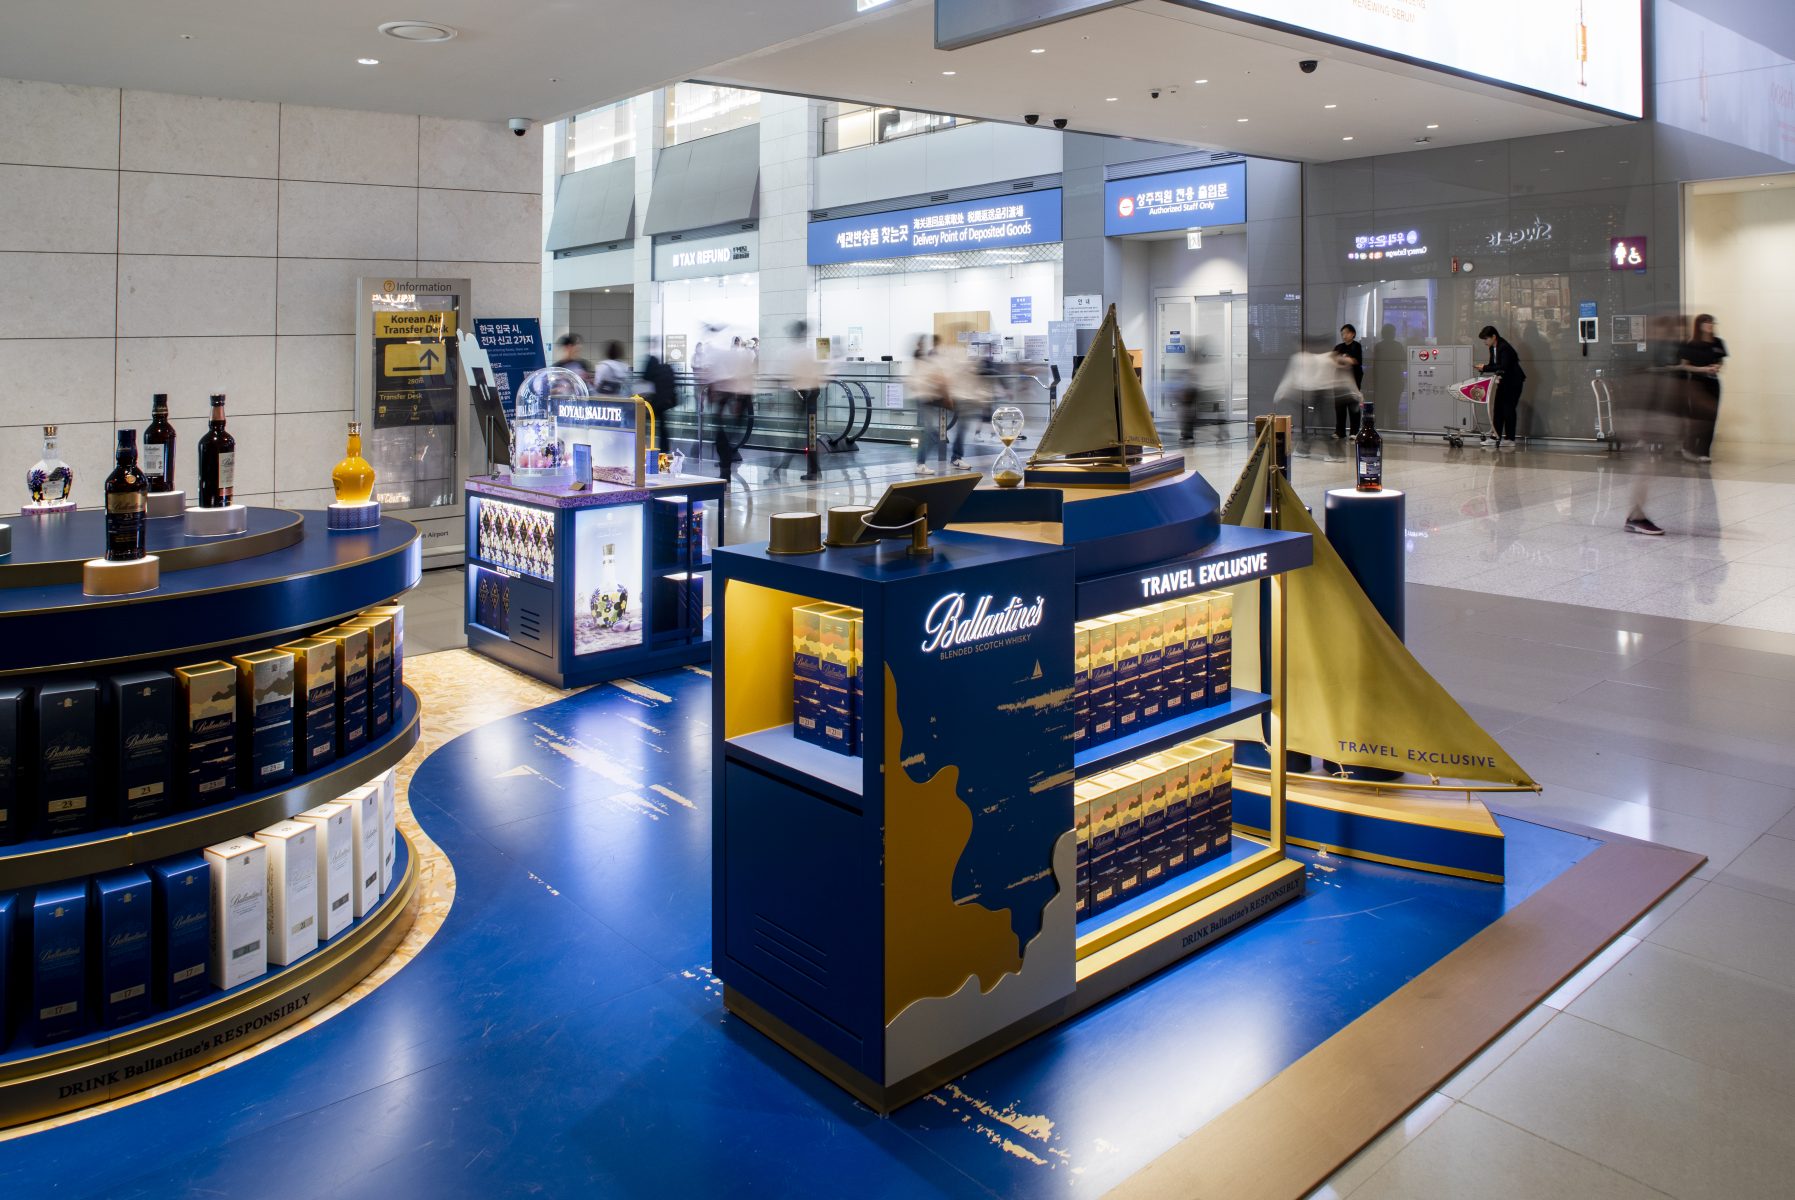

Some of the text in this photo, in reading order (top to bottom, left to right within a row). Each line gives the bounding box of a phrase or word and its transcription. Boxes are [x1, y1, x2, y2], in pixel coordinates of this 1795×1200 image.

[1149, 202, 1215, 215] Authorized Staff Only
[881, 224, 908, 244] 찾는곳
[913, 222, 1032, 247] Delivery Point of Deposited Goods
[679, 252, 696, 267] TAX
[697, 247, 731, 264] REFUND
[397, 282, 452, 292] Information
[391, 314, 443, 324] Korean Air
[384, 325, 423, 334] Transfer
[479, 324, 522, 335] 한국 입국 시,
[481, 335, 534, 346] 전자 신고 2가지
[559, 405, 585, 419] ROYAL
[1220, 483, 1242, 517] GNAC
[427, 531, 449, 539] Airport
[1141, 552, 1268, 598] TRAVEL EXCLUSIVE
[921, 592, 1045, 652] Ballantine's
[939, 633, 1032, 661] BLENDED SCOTCH WHISKY
[1338, 740, 1497, 768] TRAVEL EXCLUSIVE
[141, 786, 151, 795] 23
[62, 800, 73, 809] 23
[1182, 879, 1299, 948] DRINK Ballantine's RESPONSIBLY
[185, 969, 193, 977] 17
[58, 993, 311, 1099] DRINK Ballantine's RESPONSIBLY
